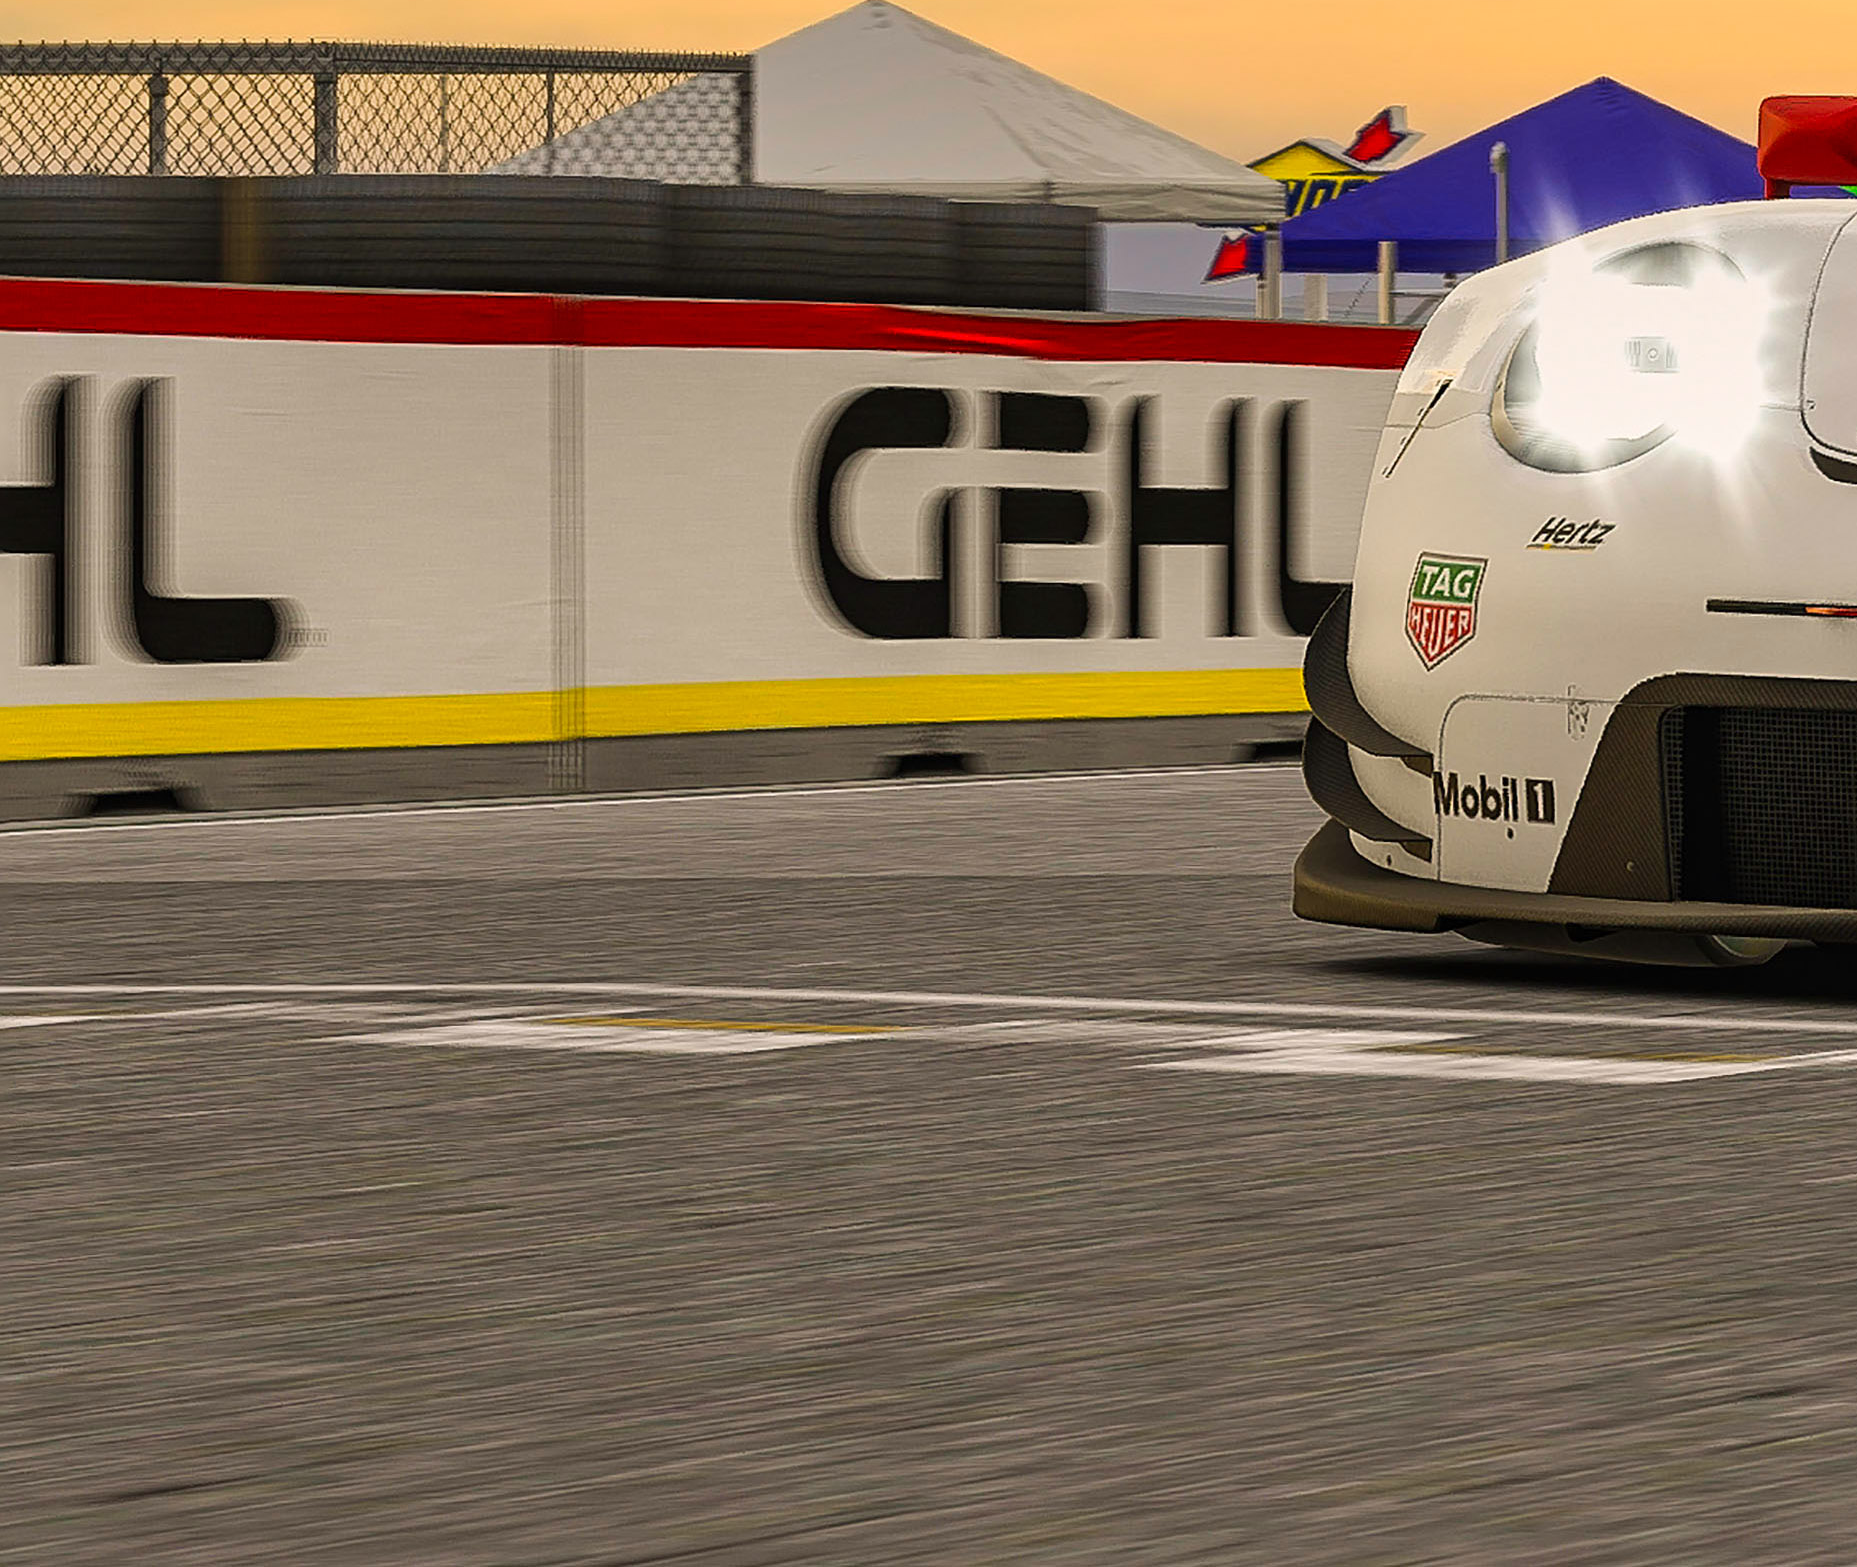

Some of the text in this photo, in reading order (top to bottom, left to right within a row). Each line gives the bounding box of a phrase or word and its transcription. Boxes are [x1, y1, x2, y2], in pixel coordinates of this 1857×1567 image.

[794, 385, 1350, 640] GEHL
[1530, 516, 1616, 546] Hertz
[1420, 564, 1475, 599] TAG
[1409, 603, 1471, 657] HEUER
[1432, 770, 1519, 823] Mobil
